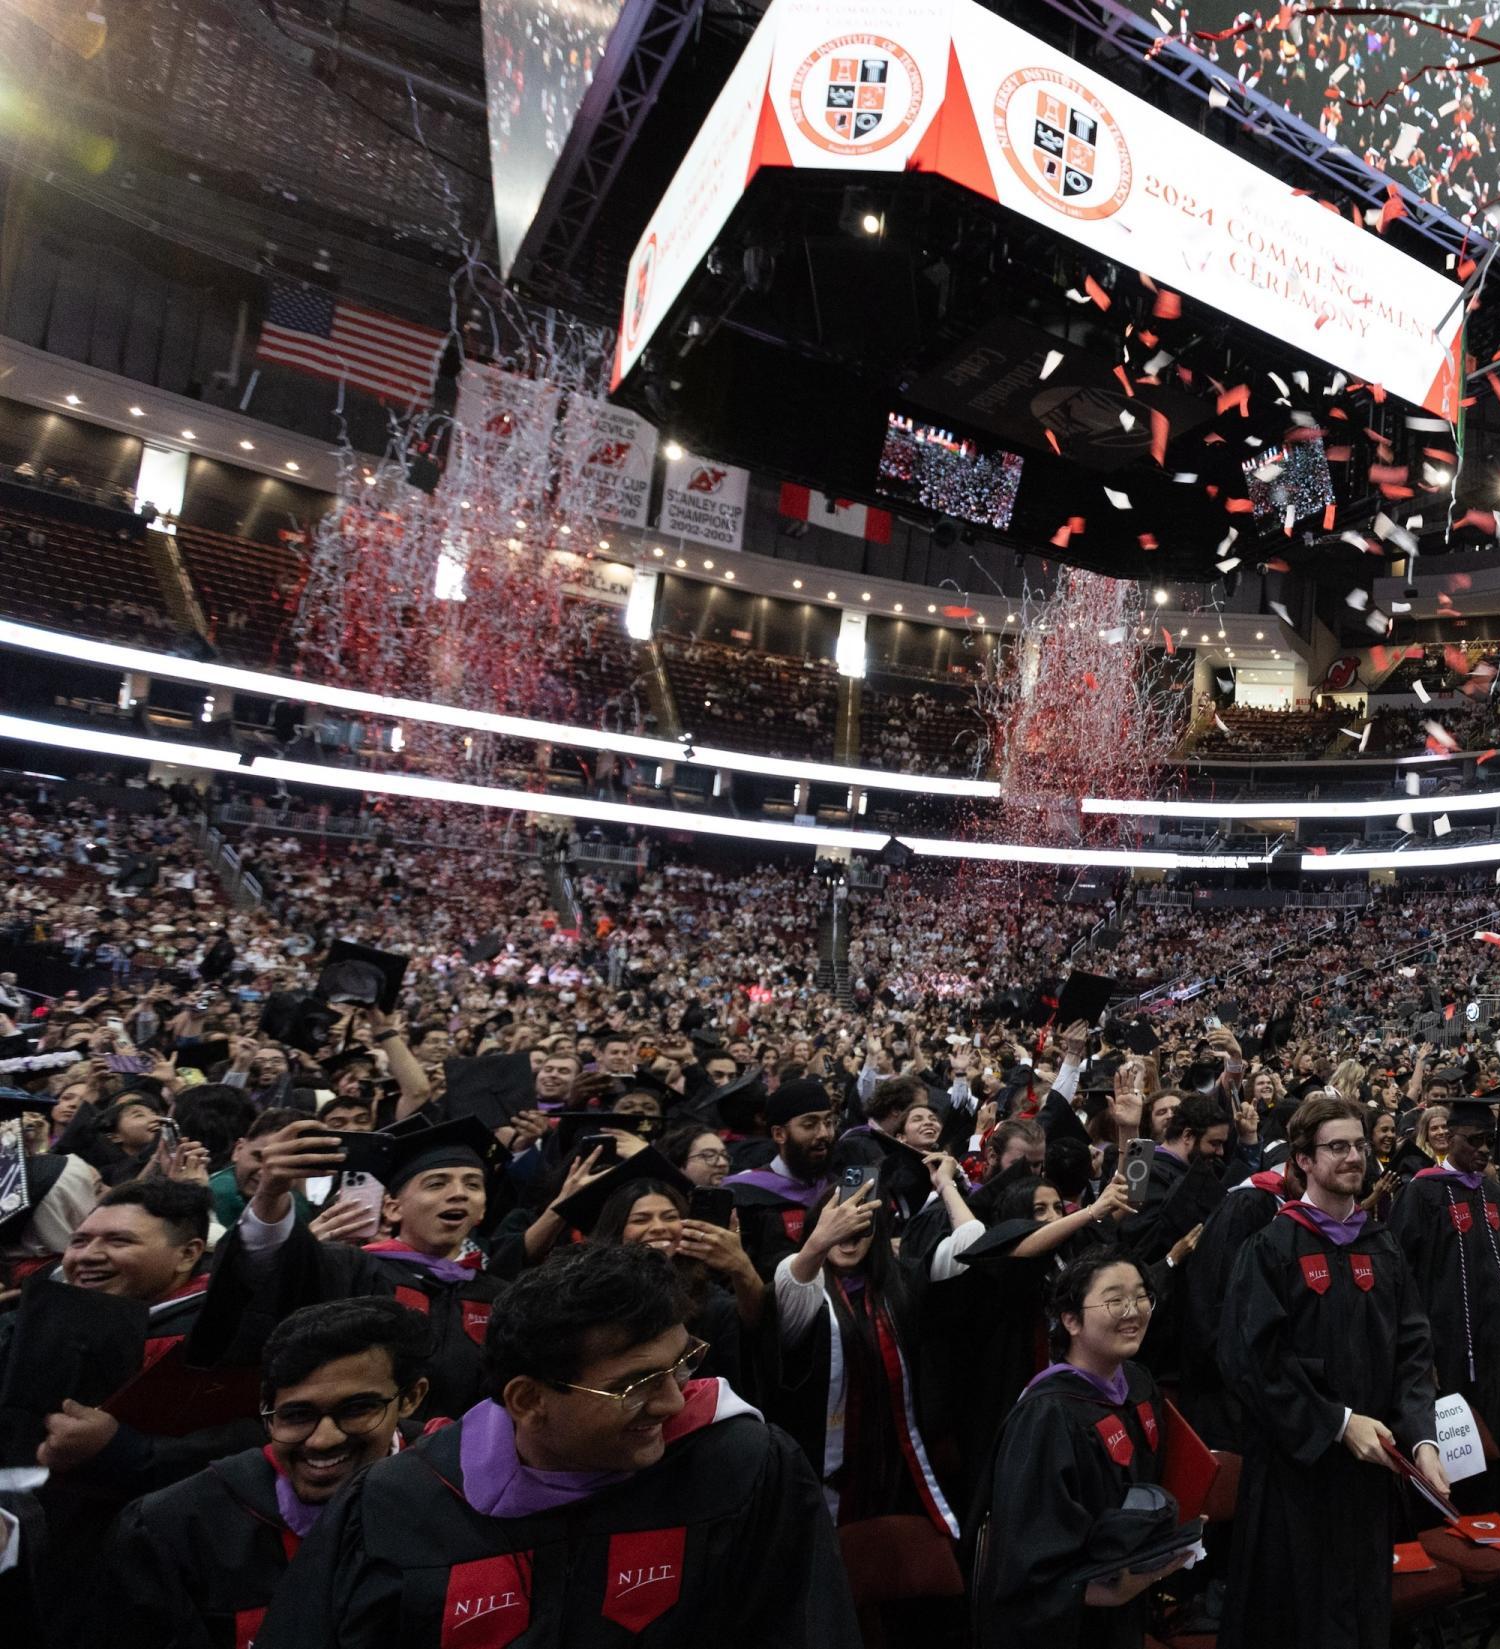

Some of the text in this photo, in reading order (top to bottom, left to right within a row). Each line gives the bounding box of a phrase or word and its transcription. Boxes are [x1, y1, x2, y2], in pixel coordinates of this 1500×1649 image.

[1145, 175, 1438, 345] 2024 COMMENCEMENT
[1228, 252, 1370, 338] CEREMONY
[666, 489, 742, 518] STANLEY CUP
[668, 504, 737, 532] CHAMPIONS
[669, 519, 733, 544] 2002-2003
[1199, 890, 1207, 898] 22
[1308, 1269, 1328, 1278] NJIT
[1438, 1424, 1471, 1442] College
[1446, 1444, 1472, 1462] HCAD
[618, 1564, 672, 1585] NJIT
[454, 1591, 515, 1616] NJIT
